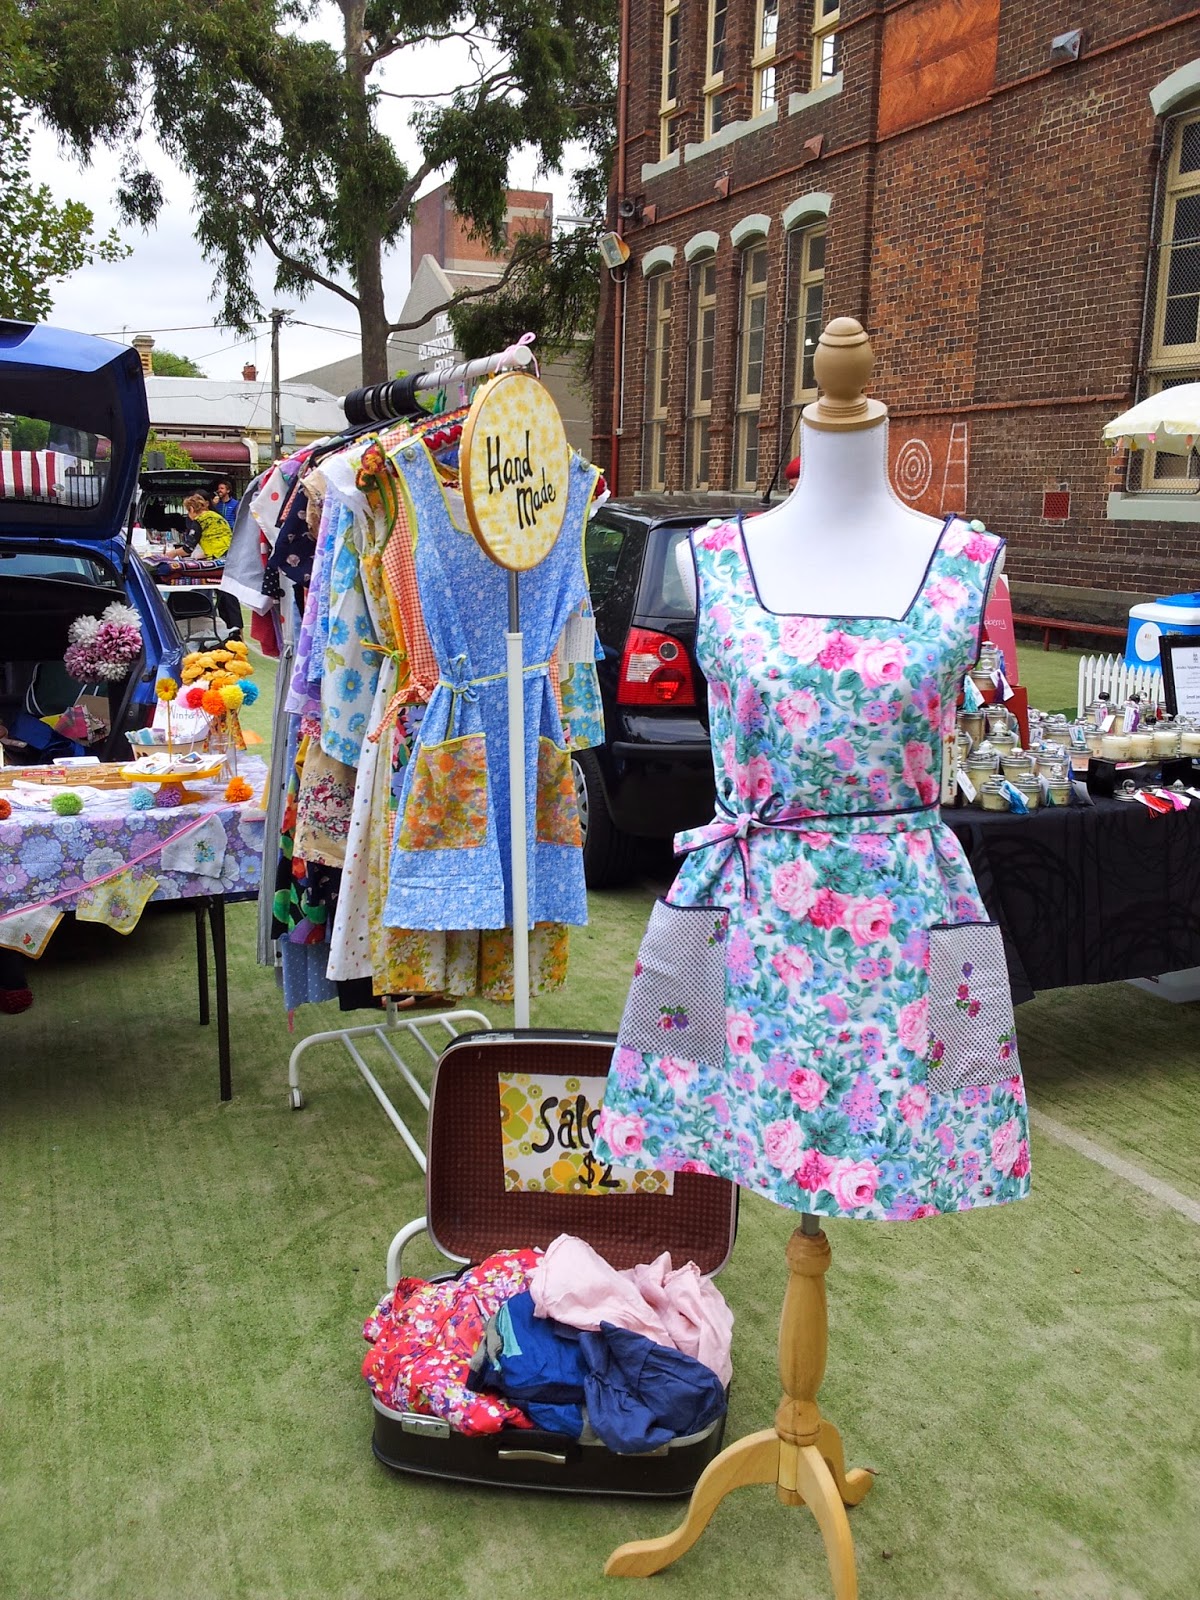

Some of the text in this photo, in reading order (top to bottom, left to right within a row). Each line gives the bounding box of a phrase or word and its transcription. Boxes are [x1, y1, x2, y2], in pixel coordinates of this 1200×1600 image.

[486, 430, 534, 495] Hand
[516, 467, 556, 530] Made
[578, 1150, 621, 1189] $2
